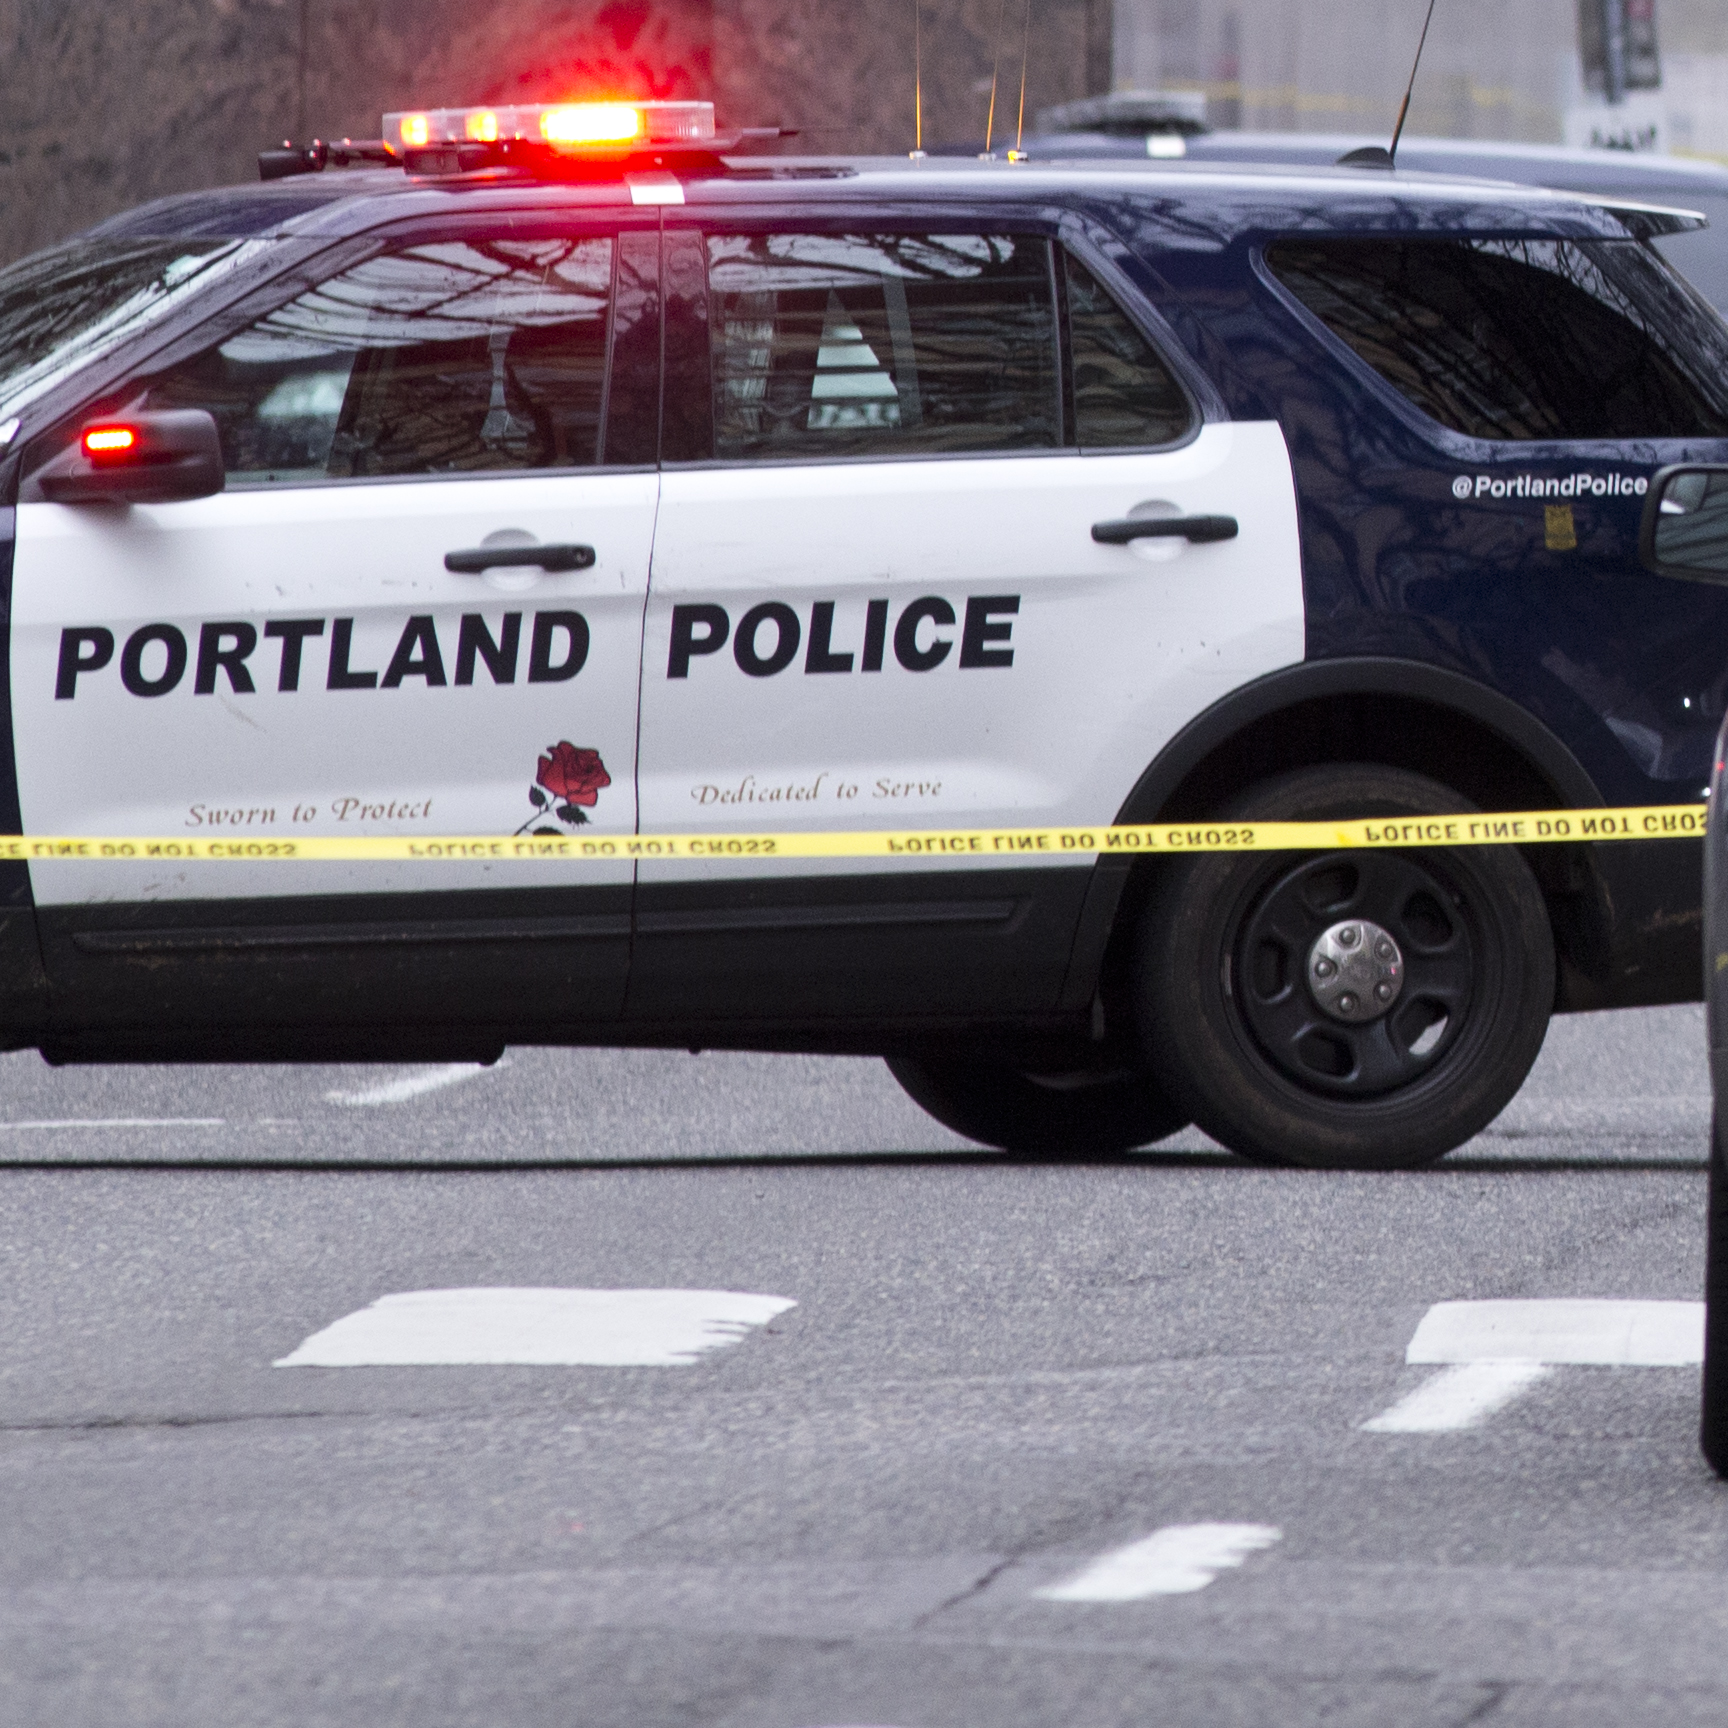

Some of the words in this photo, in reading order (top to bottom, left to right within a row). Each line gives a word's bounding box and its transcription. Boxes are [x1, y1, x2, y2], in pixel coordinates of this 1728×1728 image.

[1451, 472, 1648, 500] @PortlandPolice
[54, 609, 591, 700] PORTLAND
[666, 593, 1022, 680] POLICE
[690, 771, 829, 806] Dedicated
[835, 782, 860, 800] to
[871, 777, 943, 800] Serve
[184, 802, 277, 828] Sworn
[291, 803, 318, 824] to
[331, 796, 433, 823] Protect
